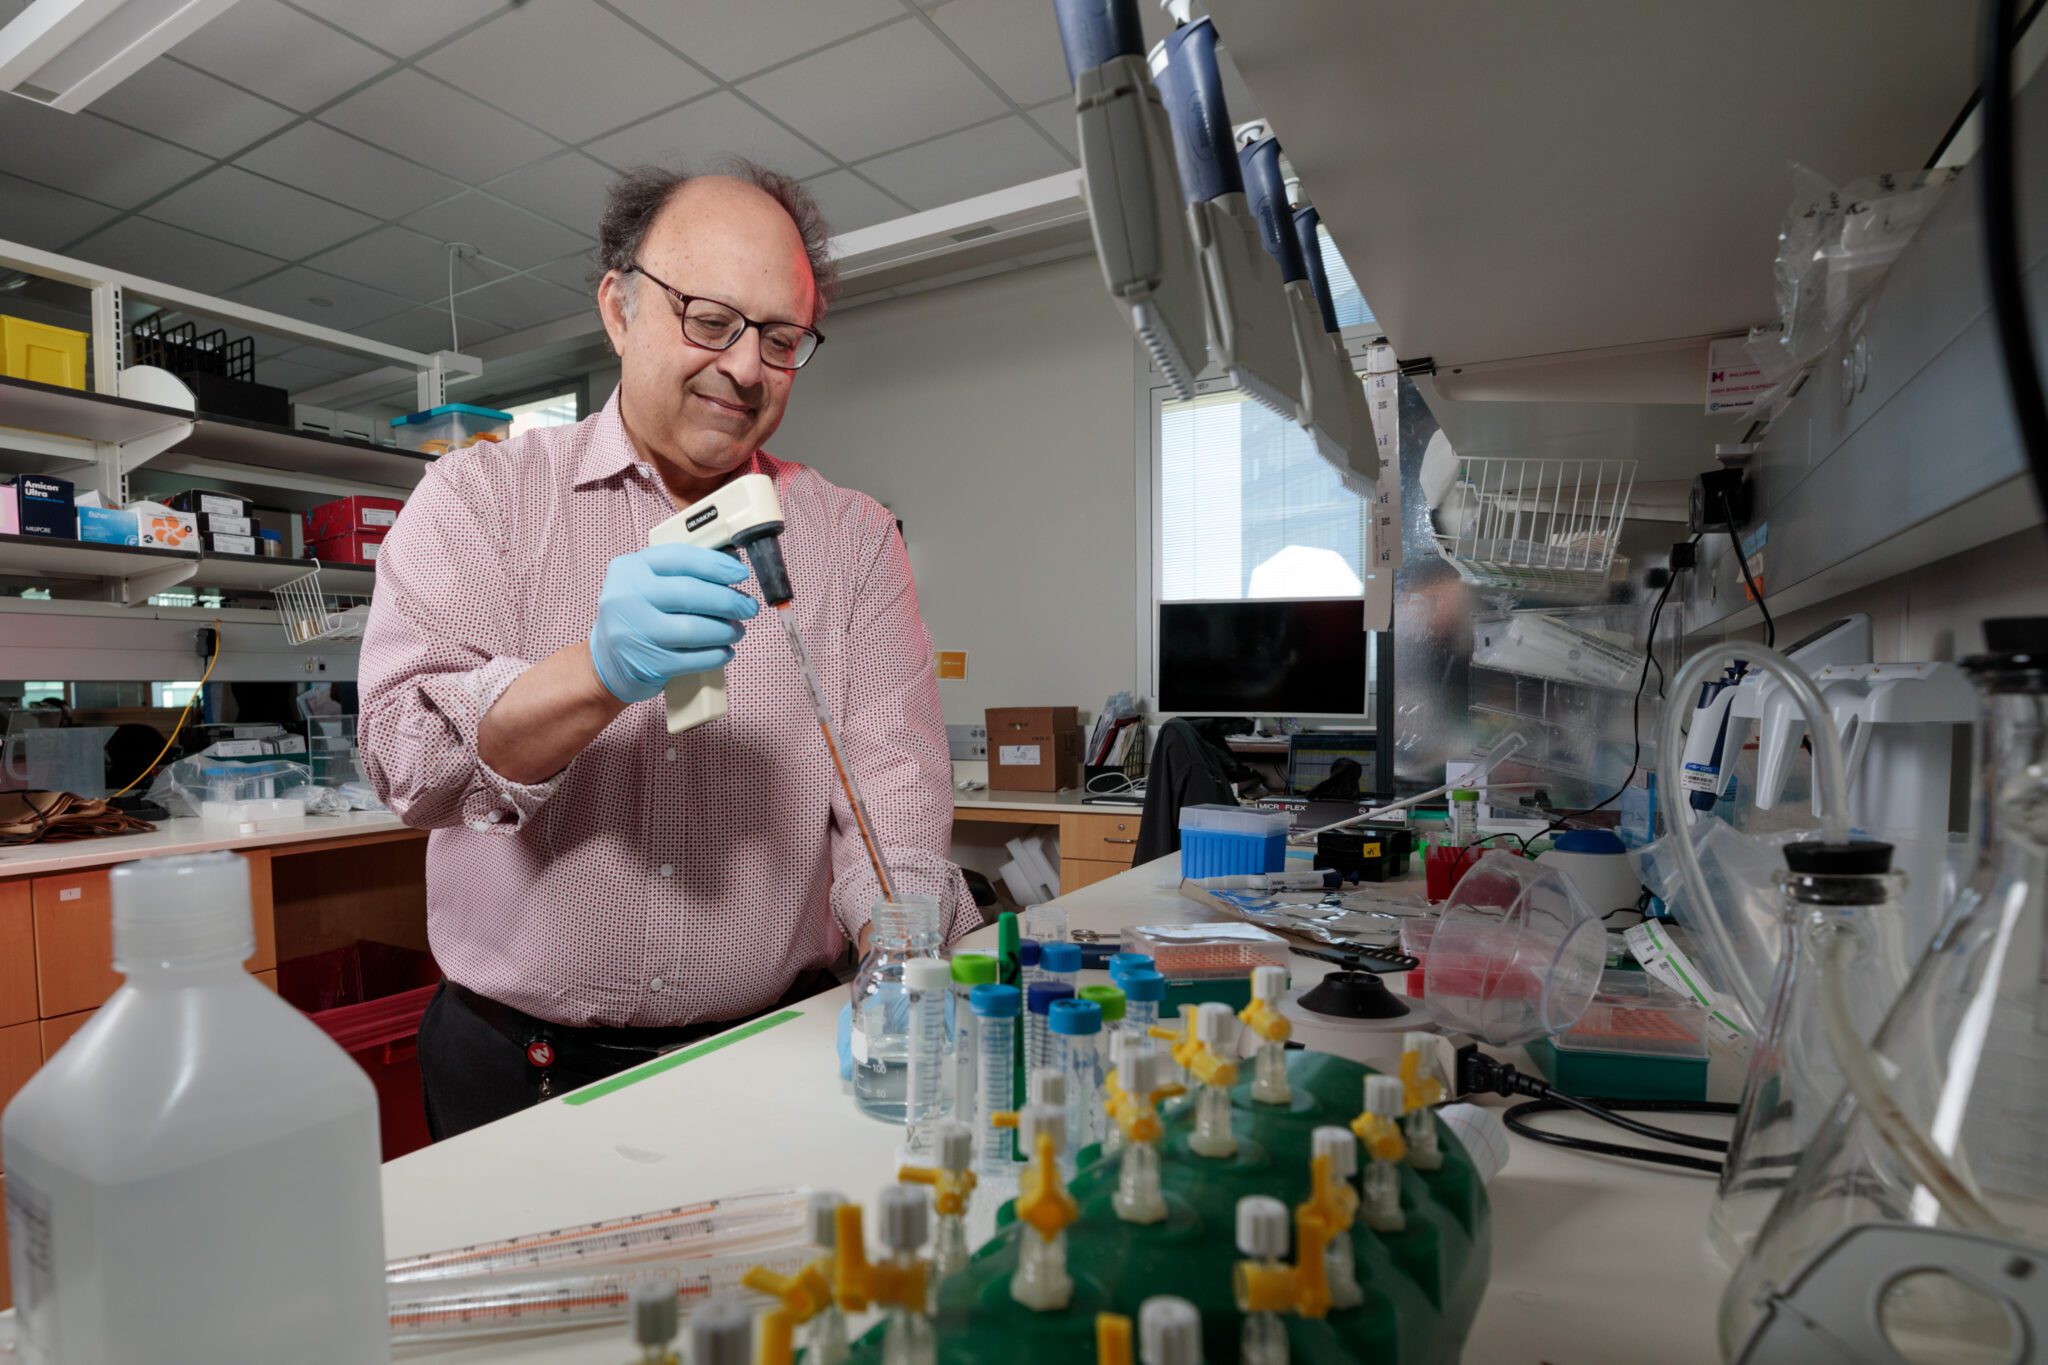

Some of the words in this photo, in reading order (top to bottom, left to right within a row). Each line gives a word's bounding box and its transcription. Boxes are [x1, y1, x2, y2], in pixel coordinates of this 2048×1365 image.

[24, 480, 59, 491] Amicon
[24, 487, 48, 498] Ultra
[1258, 803, 1307, 811] MICROFLEX
[872, 1064, 887, 1074] 100
